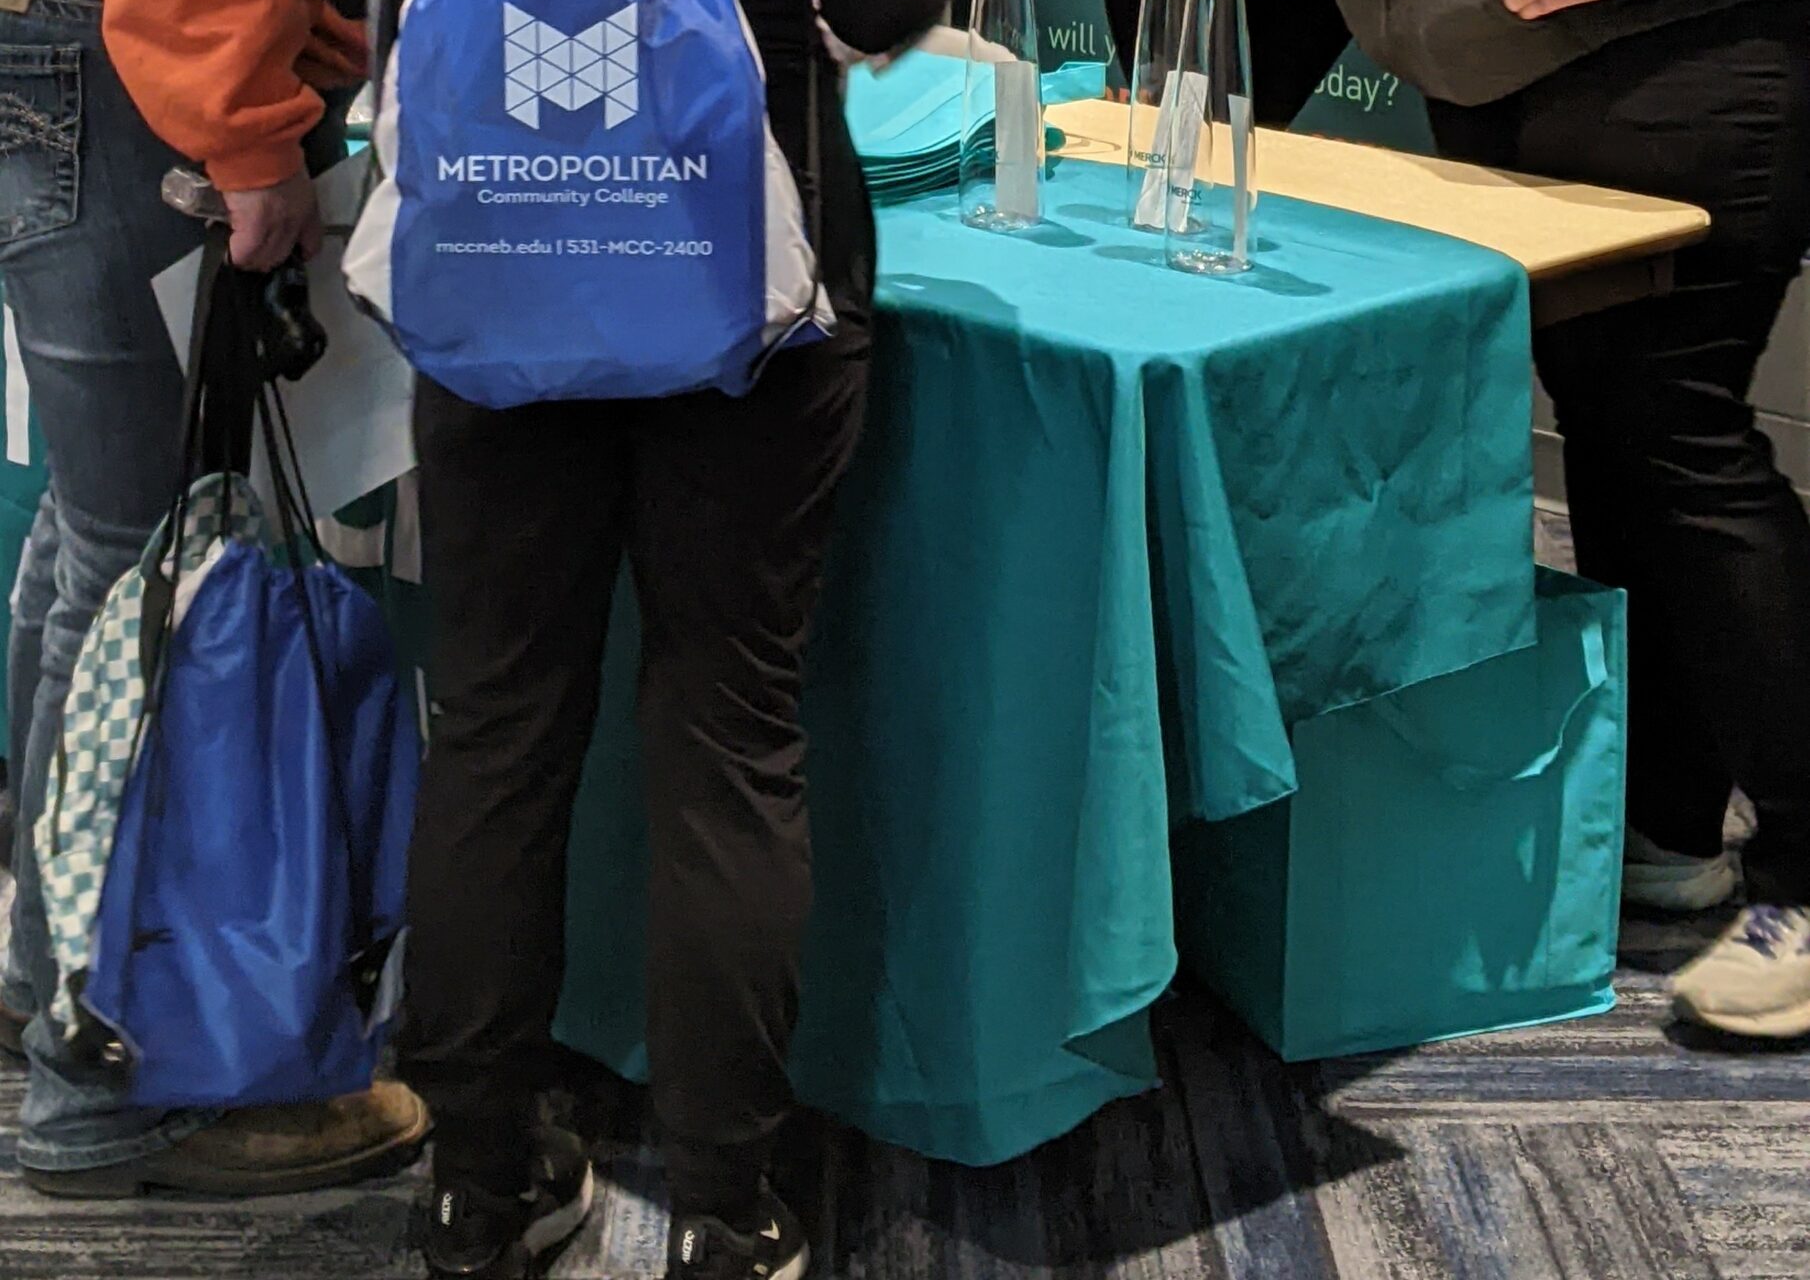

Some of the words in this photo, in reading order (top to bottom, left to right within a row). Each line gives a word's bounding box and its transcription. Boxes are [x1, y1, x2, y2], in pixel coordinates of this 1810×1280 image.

[1048, 21, 1096, 55] will
[1314, 64, 1399, 112] day?
[1134, 150, 1166, 164] MERCK
[438, 155, 707, 182] METROPOLITAN
[477, 189, 590, 207] Community
[595, 189, 669, 208] College
[1171, 185, 1202, 200] MERCK
[435, 239, 552, 255] mccneb.edu
[567, 239, 713, 256] 531-MCC-2400
